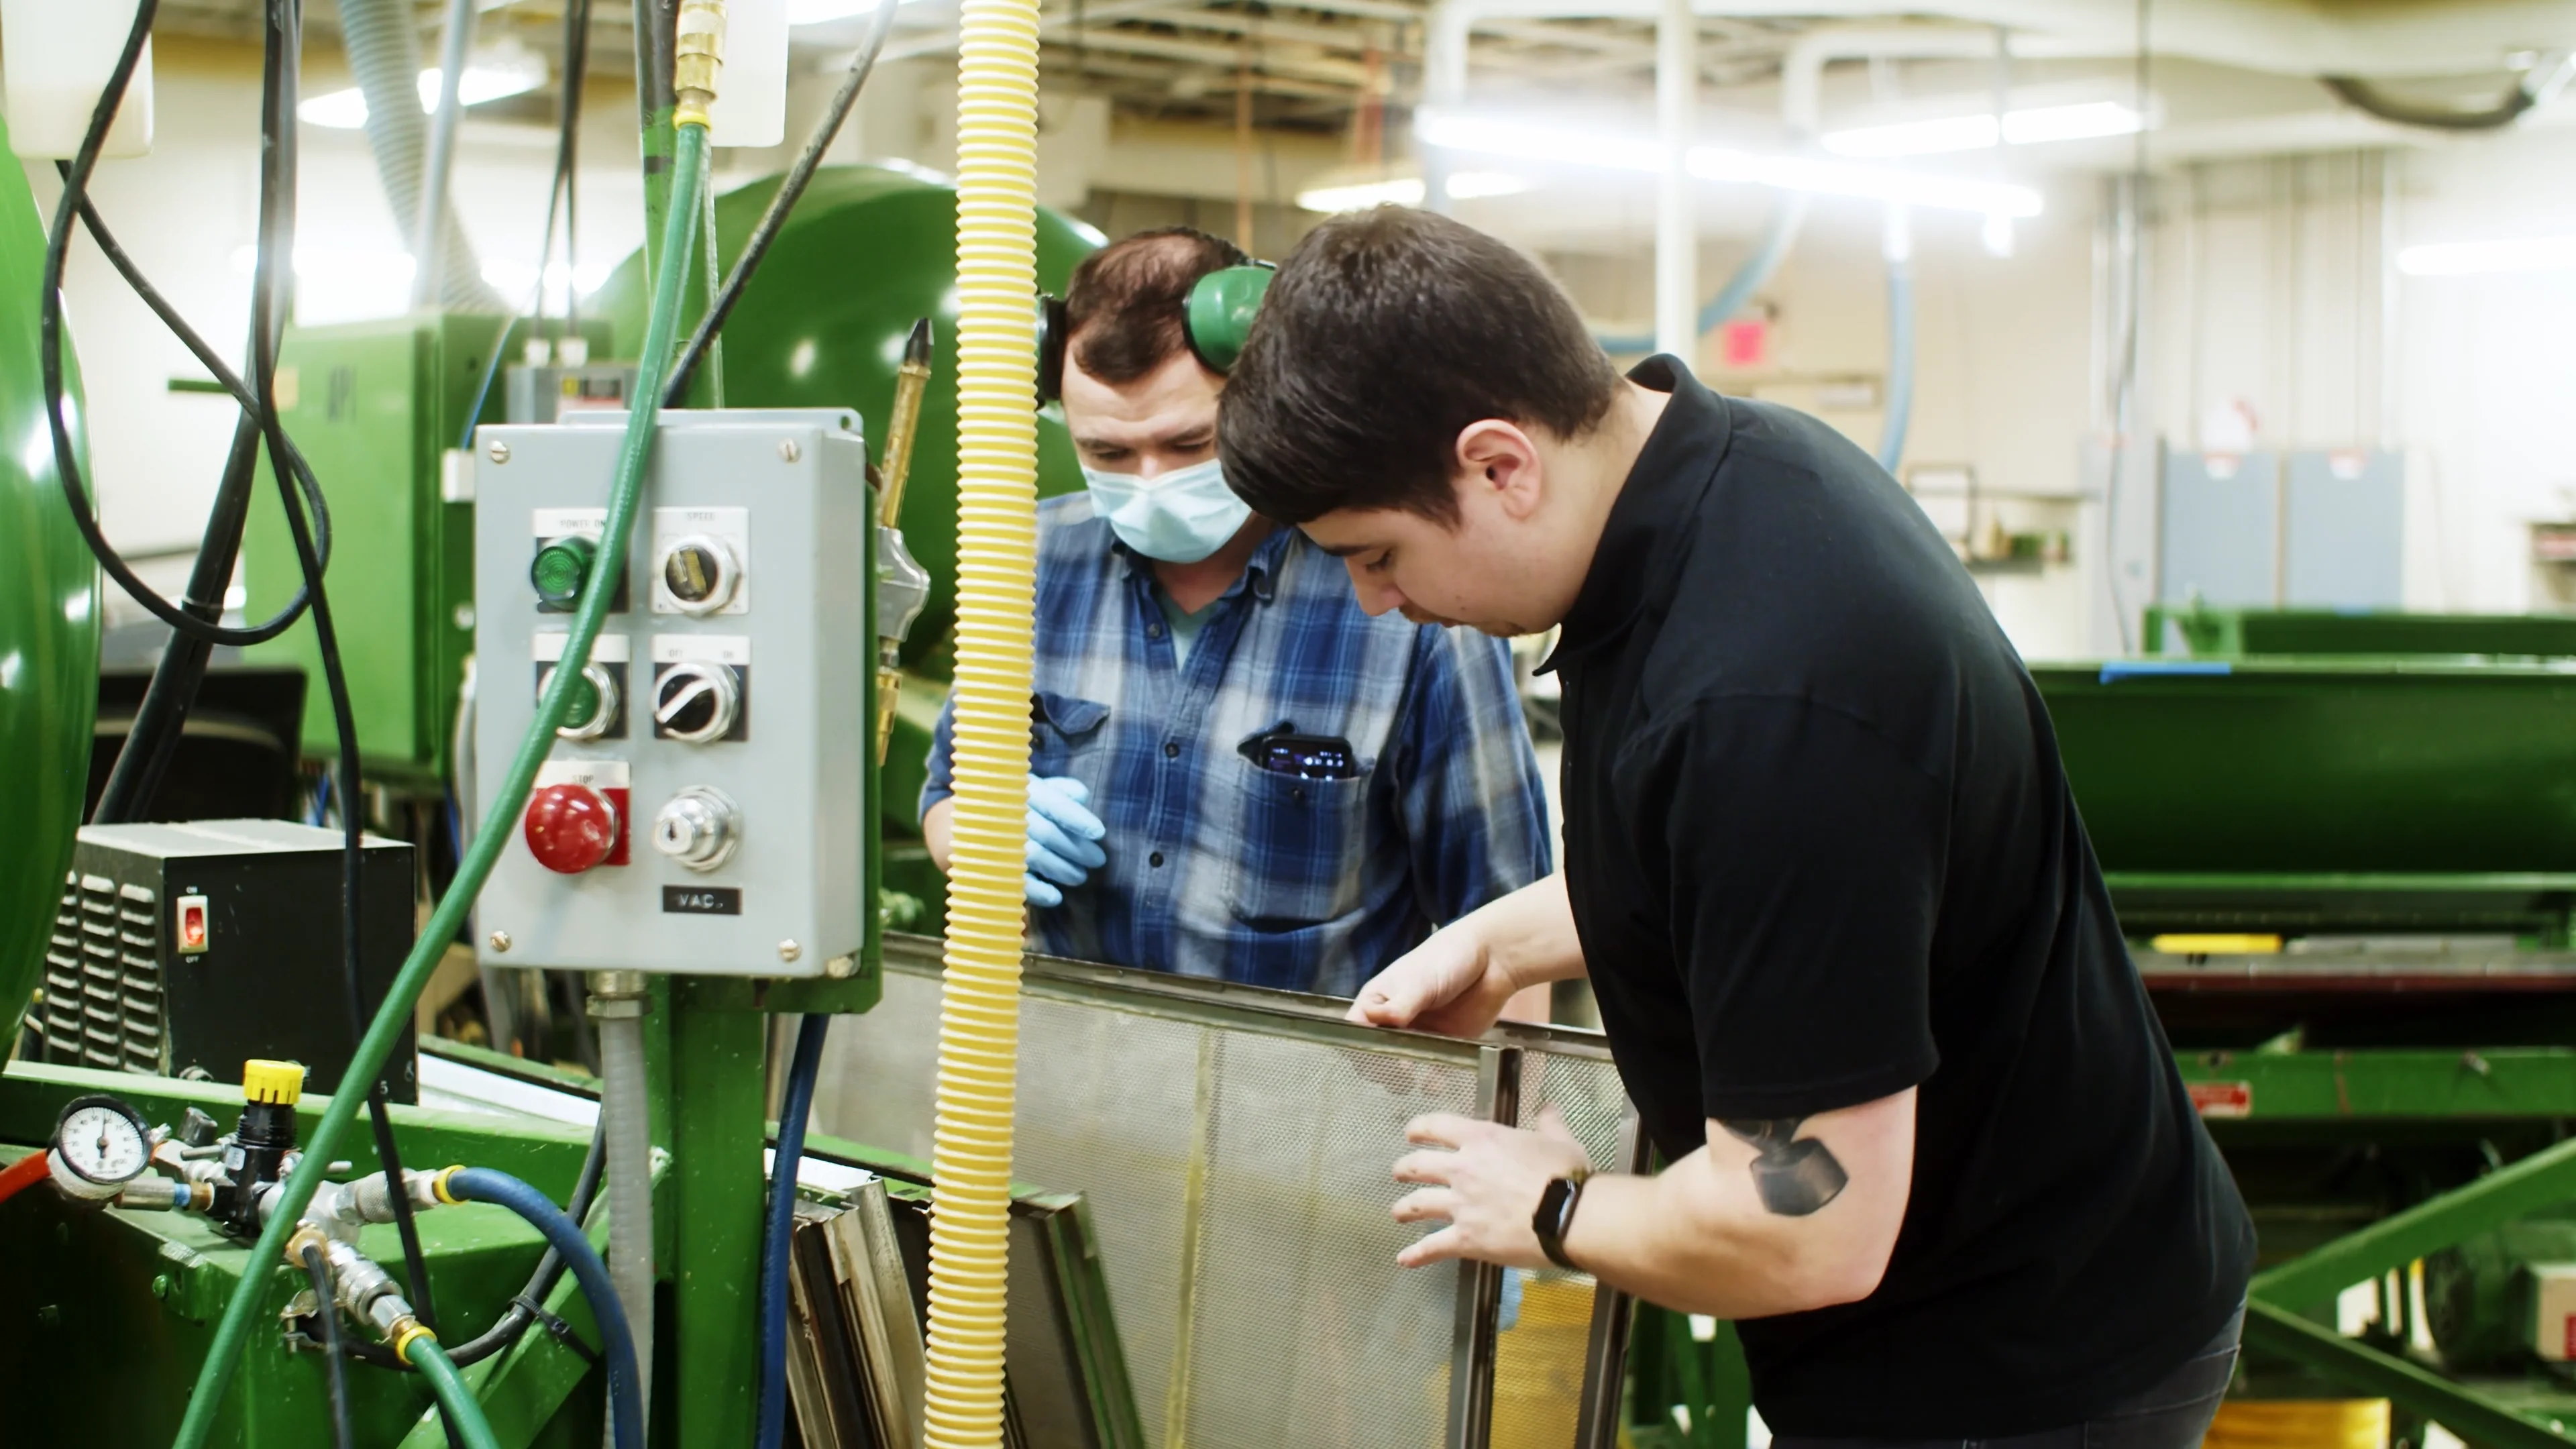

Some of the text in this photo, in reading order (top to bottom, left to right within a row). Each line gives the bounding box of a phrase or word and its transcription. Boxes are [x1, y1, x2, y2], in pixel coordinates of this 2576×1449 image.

[559, 519, 590, 529] POWER
[572, 775, 594, 784] STOP
[679, 894, 723, 909] VAC.
